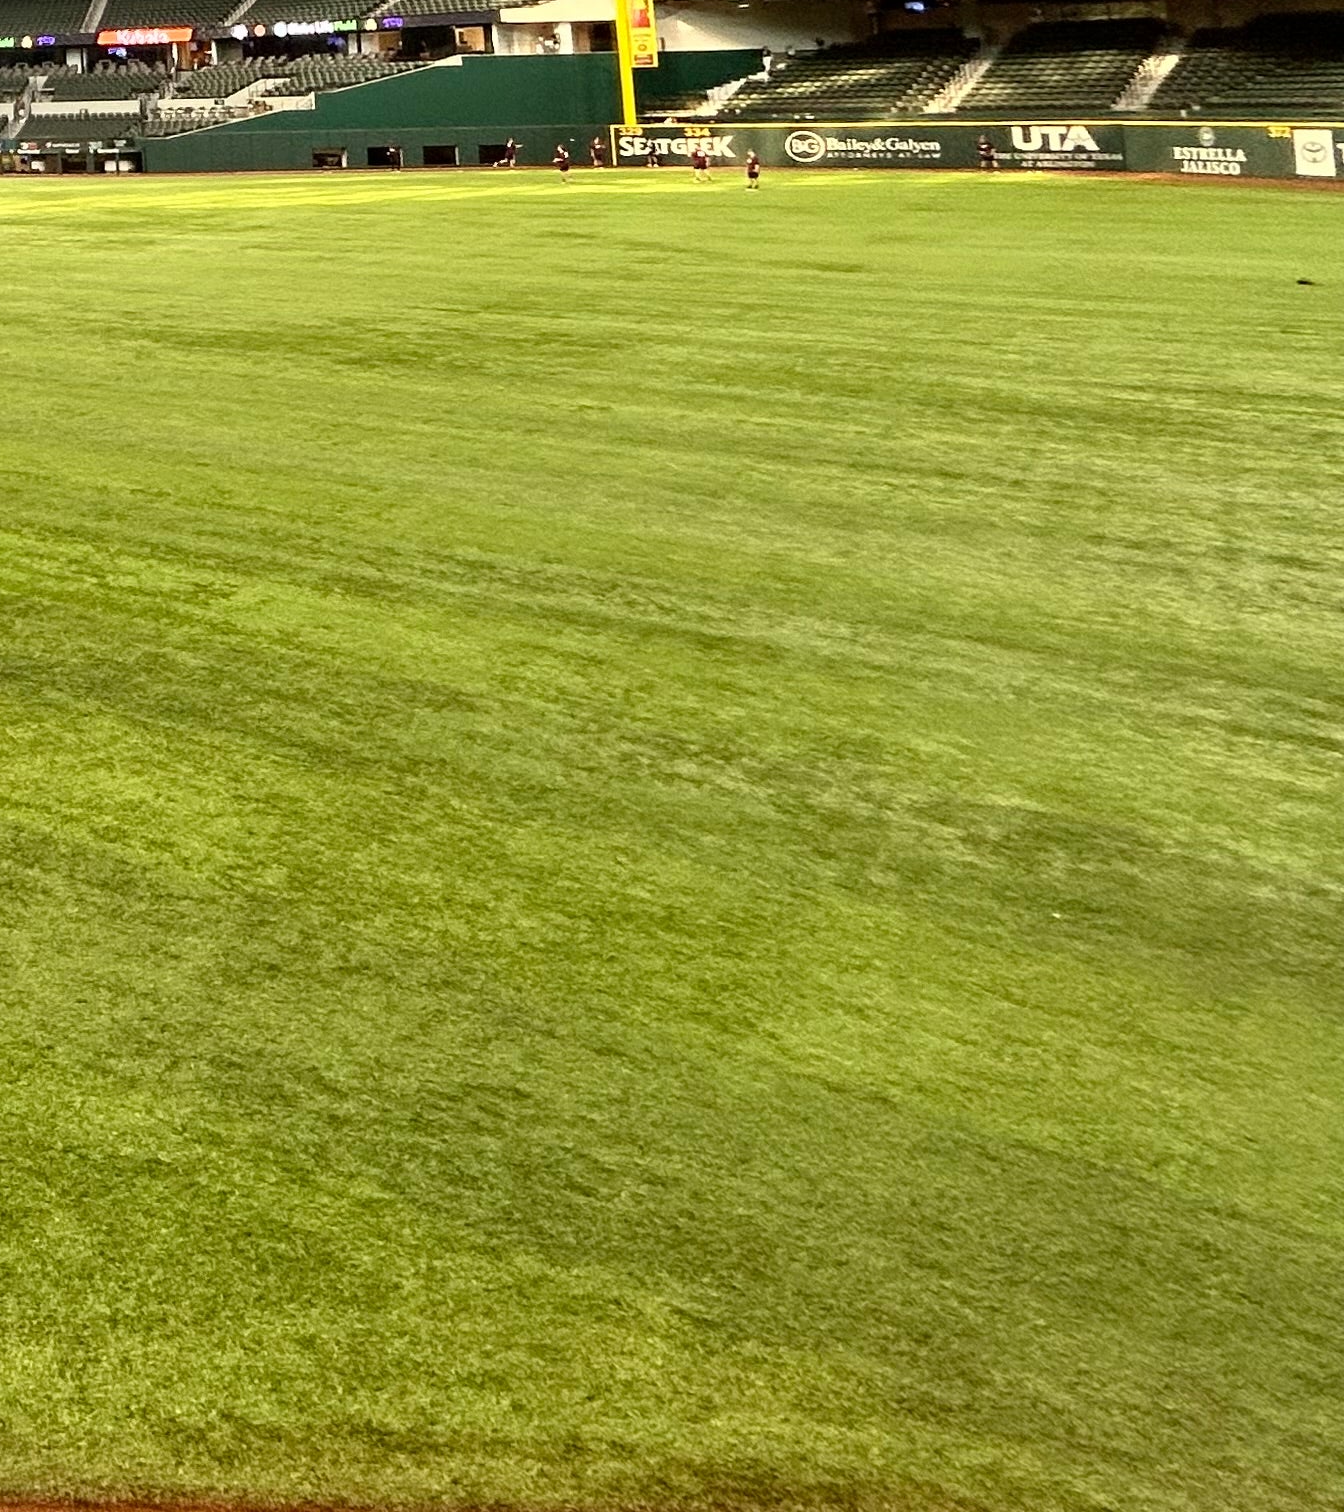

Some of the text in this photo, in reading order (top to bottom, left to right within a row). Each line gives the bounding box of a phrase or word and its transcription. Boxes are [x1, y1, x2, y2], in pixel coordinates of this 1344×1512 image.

[116, 28, 170, 46] Kubota
[1011, 126, 1100, 151] UTA
[1173, 147, 1248, 162] ESTRELLA
[1180, 160, 1241, 175] JALISCO
